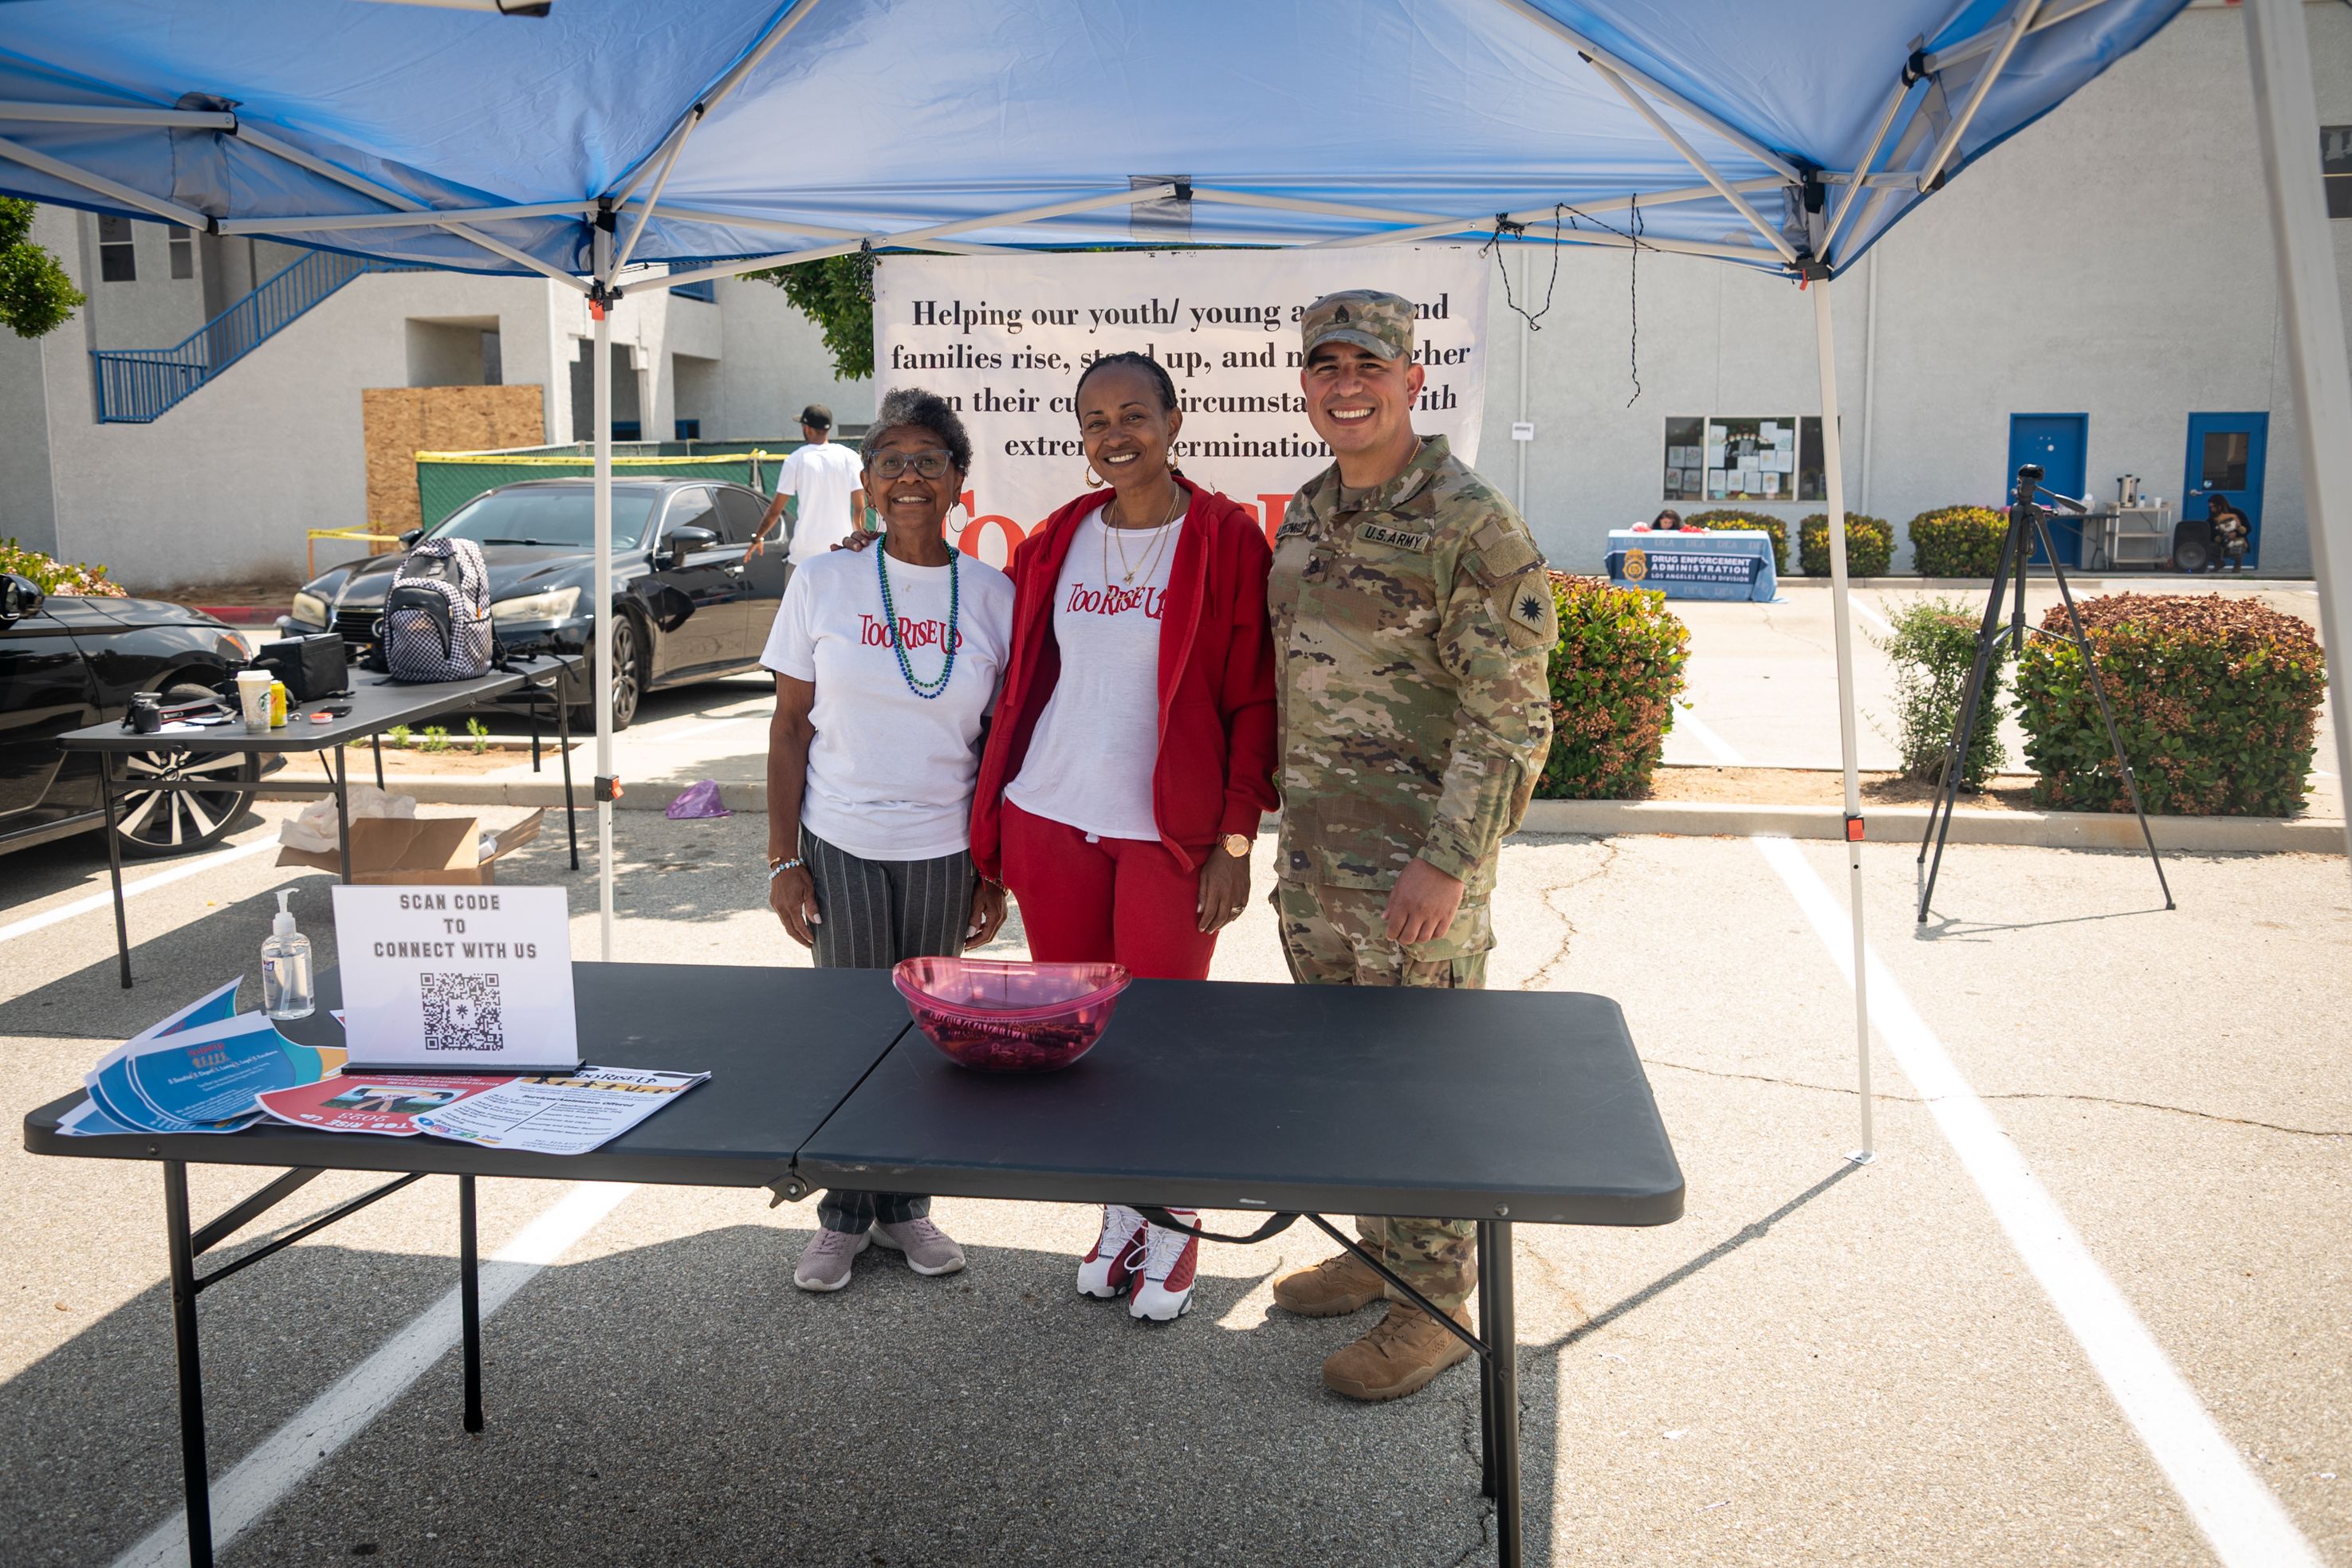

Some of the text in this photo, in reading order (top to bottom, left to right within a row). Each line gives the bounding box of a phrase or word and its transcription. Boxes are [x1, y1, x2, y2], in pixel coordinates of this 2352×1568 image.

[911, 301, 1023, 334] Helping
[1032, 308, 1079, 326] our
[1088, 298, 1180, 334] youth/
[1190, 305, 1280, 332] young
[1414, 293, 1449, 320] nd
[891, 344, 1002, 370] families
[1012, 344, 1071, 375] rise,
[1166, 351, 1212, 378] up,
[1221, 342, 1276, 368] and
[973, 387, 1040, 413] their
[1410, 383, 1457, 412] ith
[1651, 555, 1752, 566] DRUG ENFORCEMENT
[1651, 563, 1749, 574] ADMINISTRATION
[399, 894, 501, 910] SCAN CODE
[443, 918, 466, 934] TO
[373, 941, 537, 959] CONNECT WITH US
[324, 1118, 364, 1129] RISE
[337, 1112, 391, 1122] 2023
